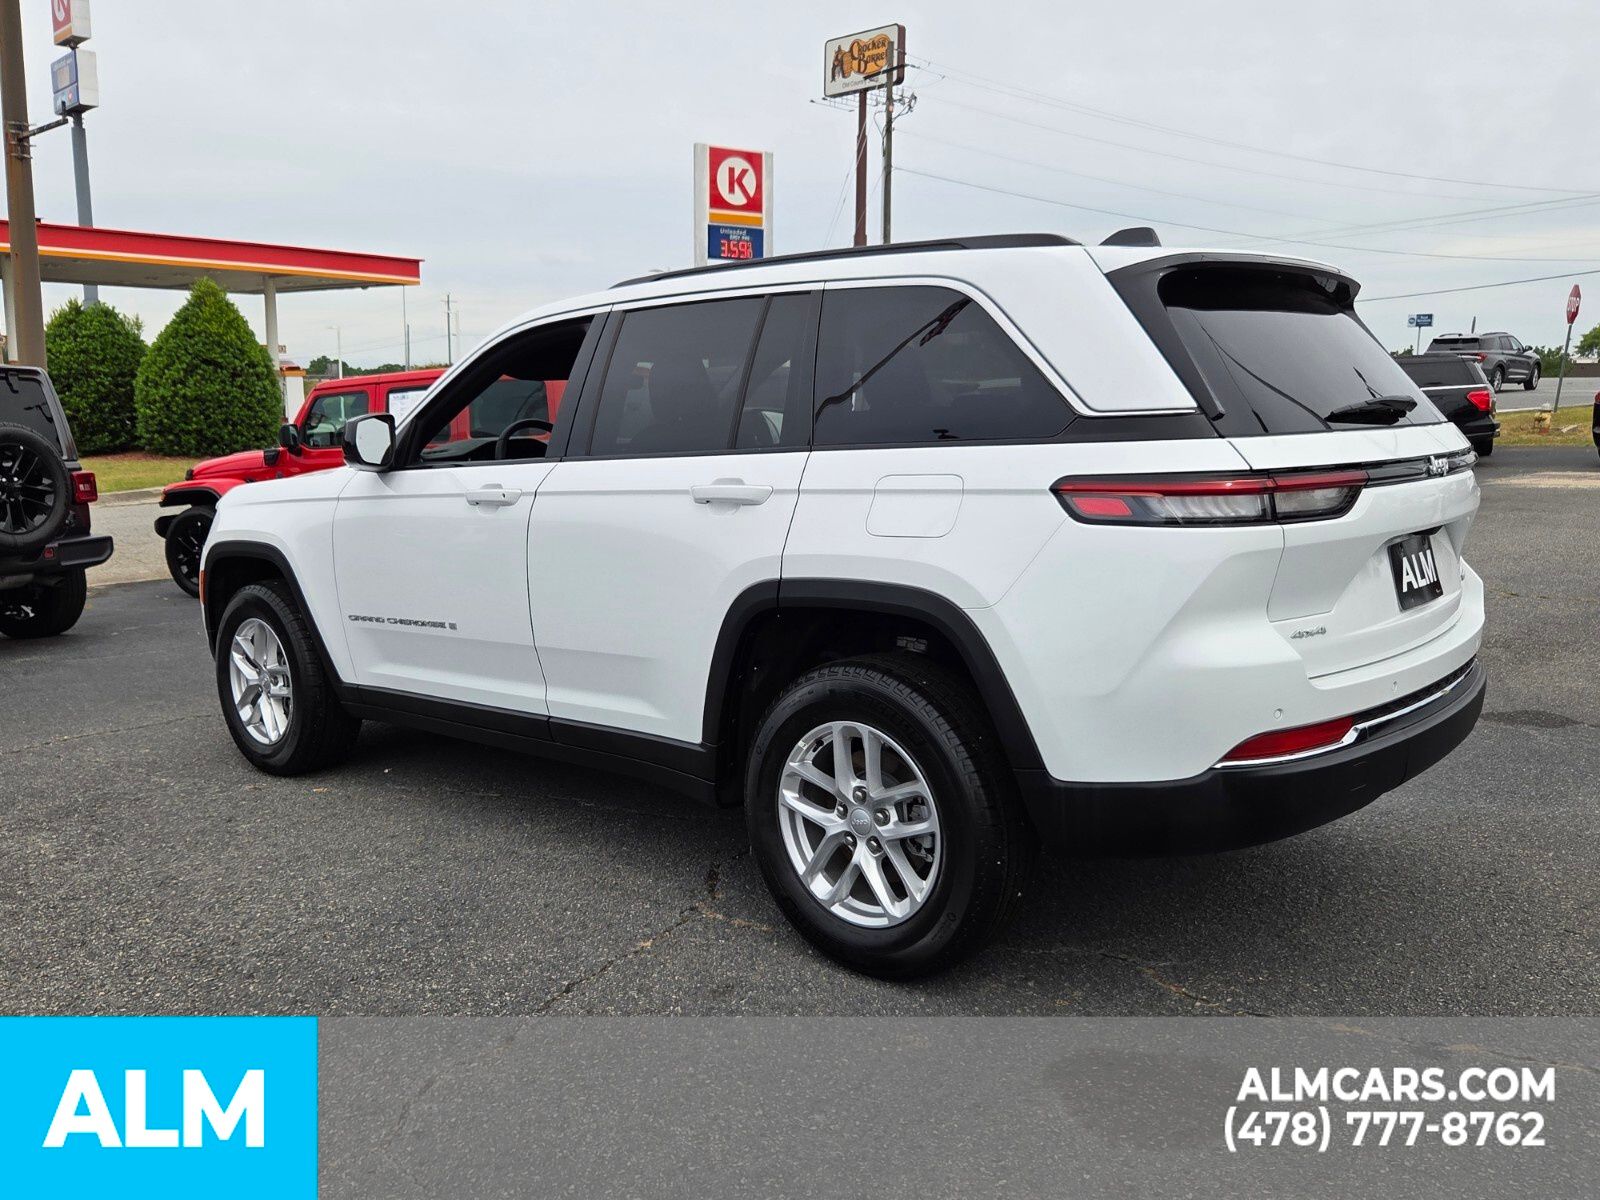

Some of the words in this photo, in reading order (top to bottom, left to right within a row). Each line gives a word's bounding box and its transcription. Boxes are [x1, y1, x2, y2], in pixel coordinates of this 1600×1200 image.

[850, 37, 887, 60] Cracker
[858, 51, 888, 73] Barrel
[727, 166, 753, 201] K
[719, 227, 747, 236] Unleaded
[1567, 296, 1580, 312] STOP
[1428, 455, 1449, 477] Jeep
[1402, 550, 1438, 593] ALM
[348, 614, 386, 624] GRAND
